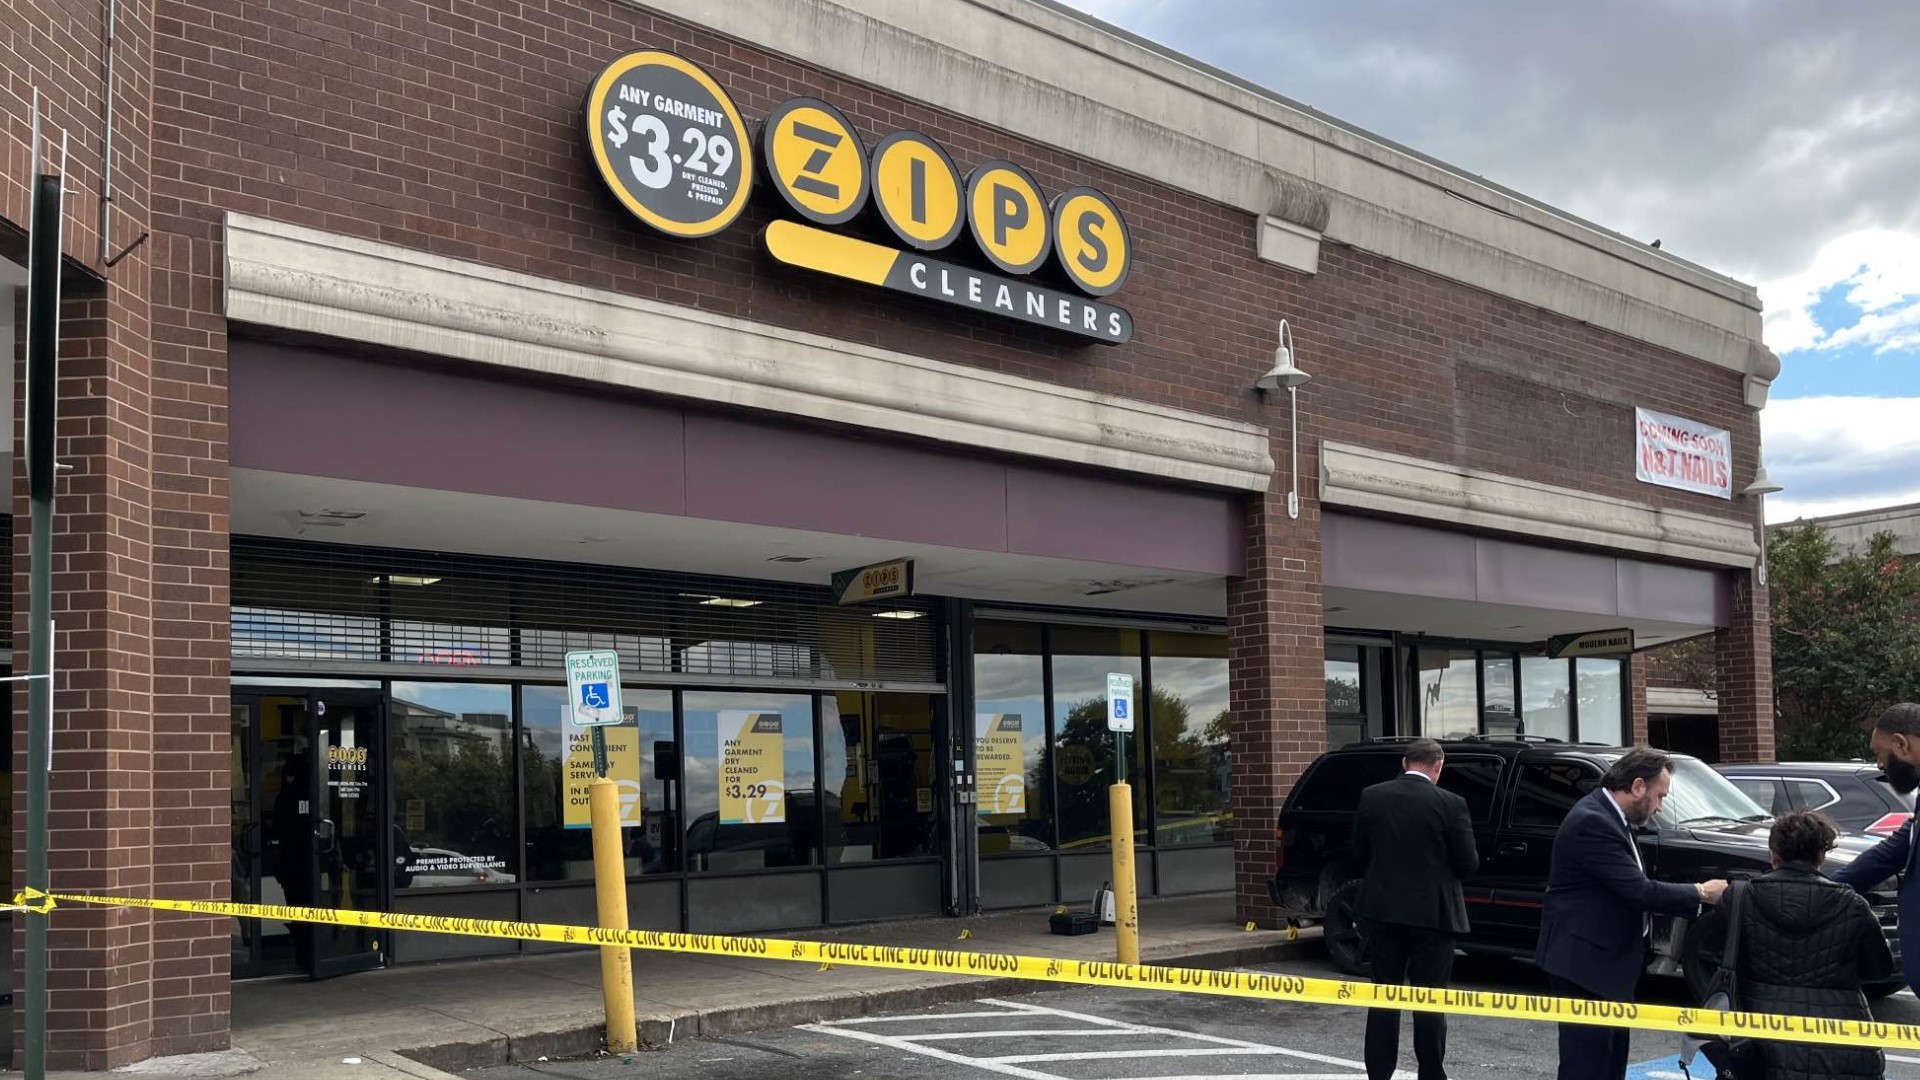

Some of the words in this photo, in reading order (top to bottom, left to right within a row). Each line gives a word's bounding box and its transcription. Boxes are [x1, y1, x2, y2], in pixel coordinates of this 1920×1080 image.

[619, 84, 650, 107] ANY
[653, 95, 724, 128] GARMENT
[607, 105, 733, 189] $3.29
[682, 171, 696, 181] DRY
[691, 182, 719, 195] PRESSED
[695, 192, 723, 205] PREPAID
[787, 117, 1112, 276] ZIPS
[910, 262, 1122, 336] CLEANERS
[1639, 421, 1689, 445] COMING
[1692, 433, 1724, 456] SOON
[1641, 443, 1678, 477] N&T
[1681, 452, 1727, 488] NAILS
[864, 569, 898, 587] ZIPS
[569, 657, 614, 669] RESERVED
[574, 670, 613, 681] PARKING
[569, 734, 589, 742] FAST
[330, 747, 365, 762] ZIPS
[570, 761, 595, 769] SAME
[570, 771, 595, 779] SERVI
[570, 787, 581, 795] IN
[726, 784, 767, 799] $3.29
[449, 856, 486, 864] PROTECTED
[459, 861, 506, 869] SURVEILLANCE
[588, 927, 633, 944] POLICE
[636, 931, 664, 946] LINE
[669, 932, 687, 948] DO
[691, 934, 716, 950] NOT
[721, 936, 766, 954] CROSS
[819, 942, 868, 961] POLICE
[873, 945, 904, 963] LINE
[909, 948, 929, 965] DO
[934, 950, 962, 967] NOT
[968, 952, 1018, 972] CROSS
[1078, 961, 1133, 981] POLICE
[1139, 965, 1174, 984] LINE
[1180, 968, 1202, 986] DO
[1209, 970, 1241, 990] NOT
[1248, 973, 1305, 994] CROSS
[1373, 983, 1437, 1004] POLICE
[1444, 989, 1485, 1008] LINE
[1492, 993, 1517, 1010] DO
[1525, 995, 1562, 1014] NOT
[1570, 999, 1638, 1020] CROSS
[1719, 1011, 1794, 1032] POLICE
[1802, 1016, 1850, 1036] LINE
[1859, 1020, 1888, 1039] DO
